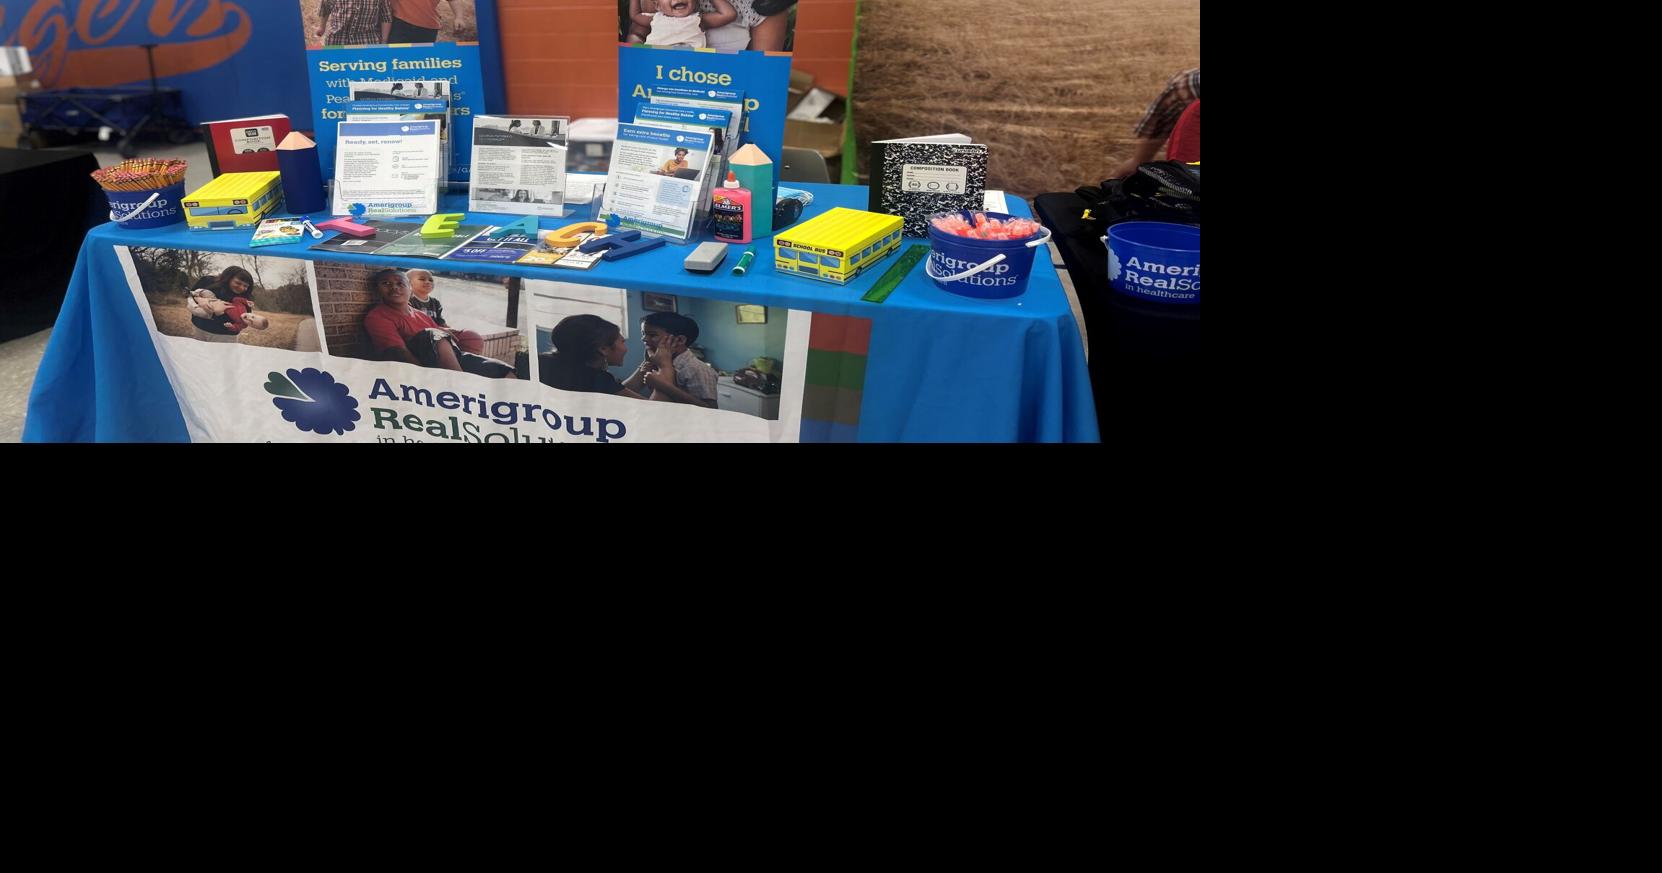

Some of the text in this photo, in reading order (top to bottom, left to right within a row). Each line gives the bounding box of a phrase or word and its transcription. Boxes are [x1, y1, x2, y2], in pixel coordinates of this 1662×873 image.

[319, 57, 462, 72] Serving families
[655, 65, 732, 86] I chose
[321, 108, 346, 119] for
[793, 243, 813, 251] SCHOOL
[1126, 256, 1200, 276] Ameri
[1125, 283, 1195, 299] in healthcare
[368, 378, 627, 443] Amerigroup
